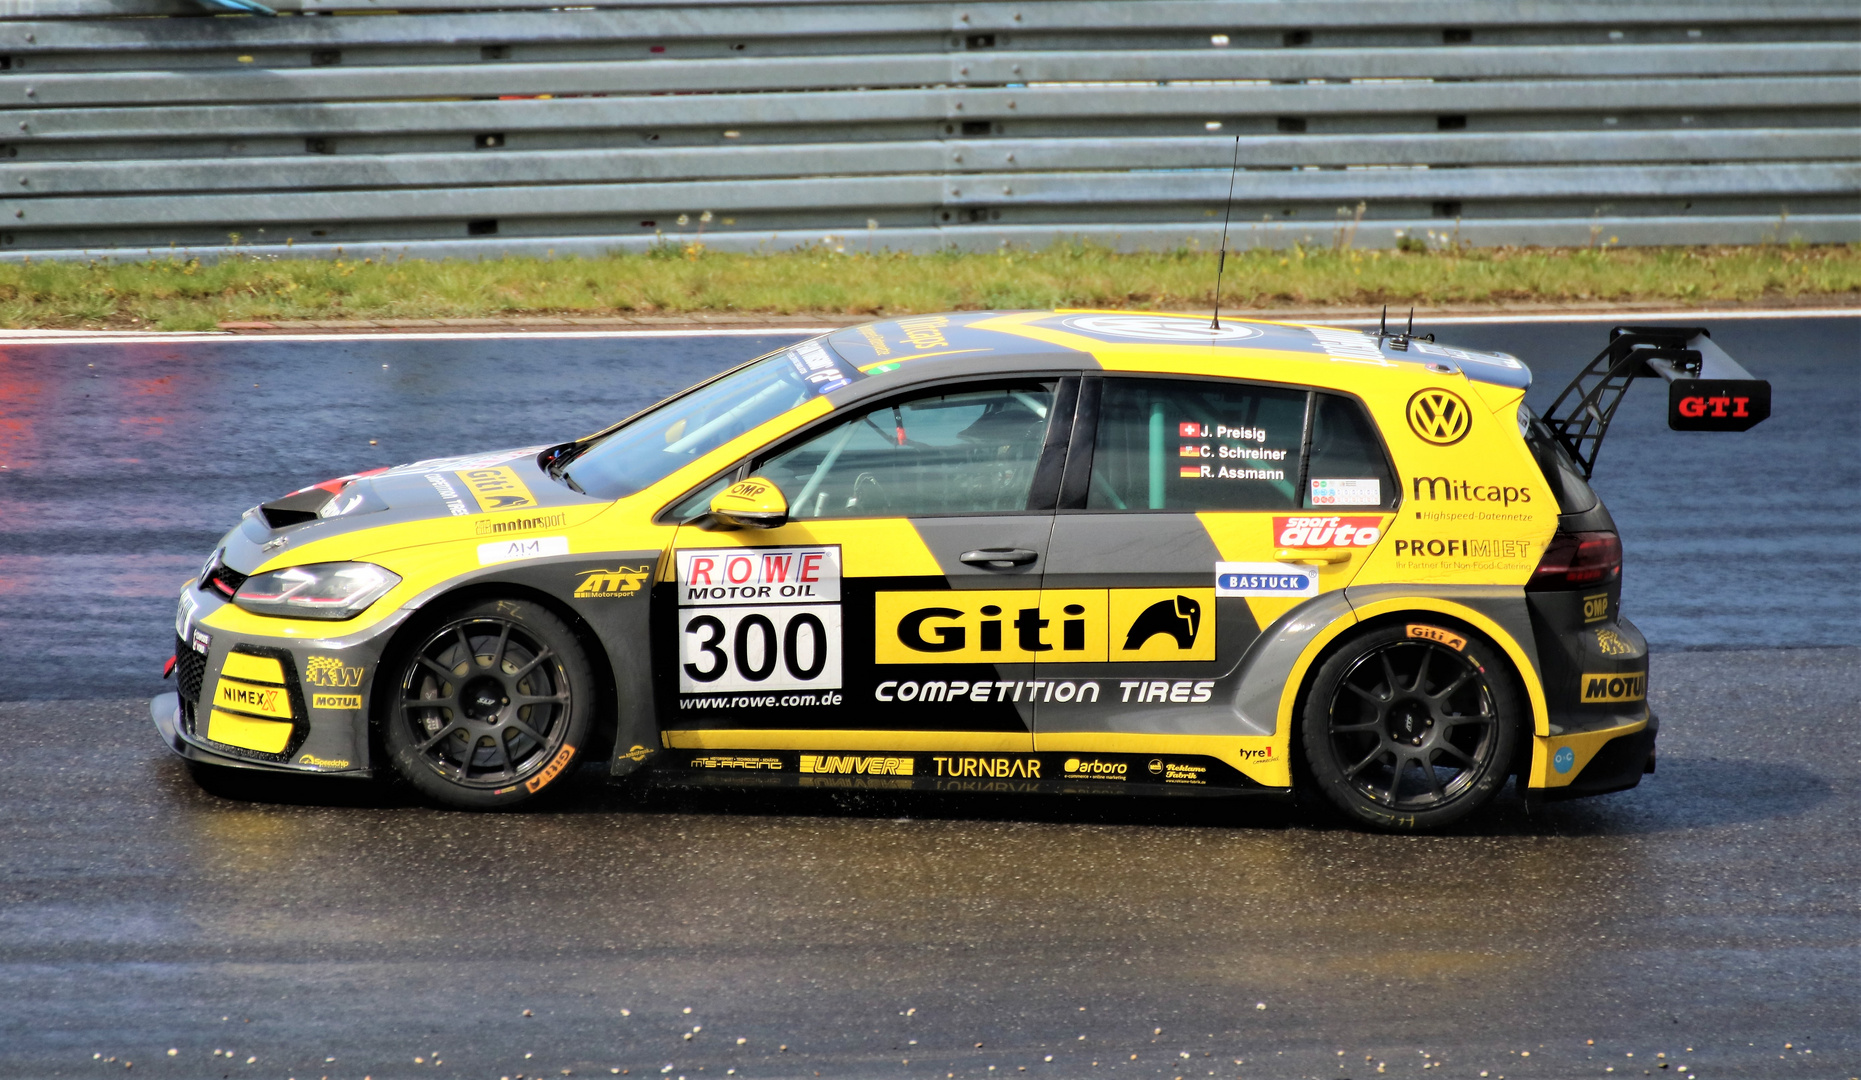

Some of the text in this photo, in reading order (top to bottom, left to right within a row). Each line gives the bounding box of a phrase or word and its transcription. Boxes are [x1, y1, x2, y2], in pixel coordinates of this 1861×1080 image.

[1679, 396, 1749, 417] GTI
[1200, 425, 1266, 442] J. Preisig
[1200, 445, 1286, 460] C. Schreiner
[1200, 466, 1284, 480] R. Assmann
[731, 484, 765, 497] OMP
[1286, 517, 1341, 529] sport
[1423, 512, 1533, 521] Highspeed-Datennetze
[1280, 524, 1381, 546] auto
[1395, 540, 1530, 557] PROFIMIET
[688, 553, 823, 585] ROWE
[1440, 561, 1452, 569] für
[575, 573, 649, 592] ATS
[1229, 576, 1299, 588] BASTUCK
[688, 585, 816, 599] MOTOR OIL
[1584, 598, 1608, 617] OMP
[897, 604, 1085, 653] Giti
[1411, 627, 1444, 640] Giti
[683, 612, 827, 682] 300
[315, 667, 363, 686] KW
[679, 691, 842, 709] www.rowe.com.de
[875, 680, 1215, 703] COMPETITION TIRES
[315, 697, 358, 707] MOTUL
[547, 750, 571, 778] Giti
[933, 757, 1041, 778] TURNBAR
[1079, 759, 1127, 774] arboro
[1166, 764, 1206, 772] Reklame
[1166, 771, 1197, 779] Fabrik
